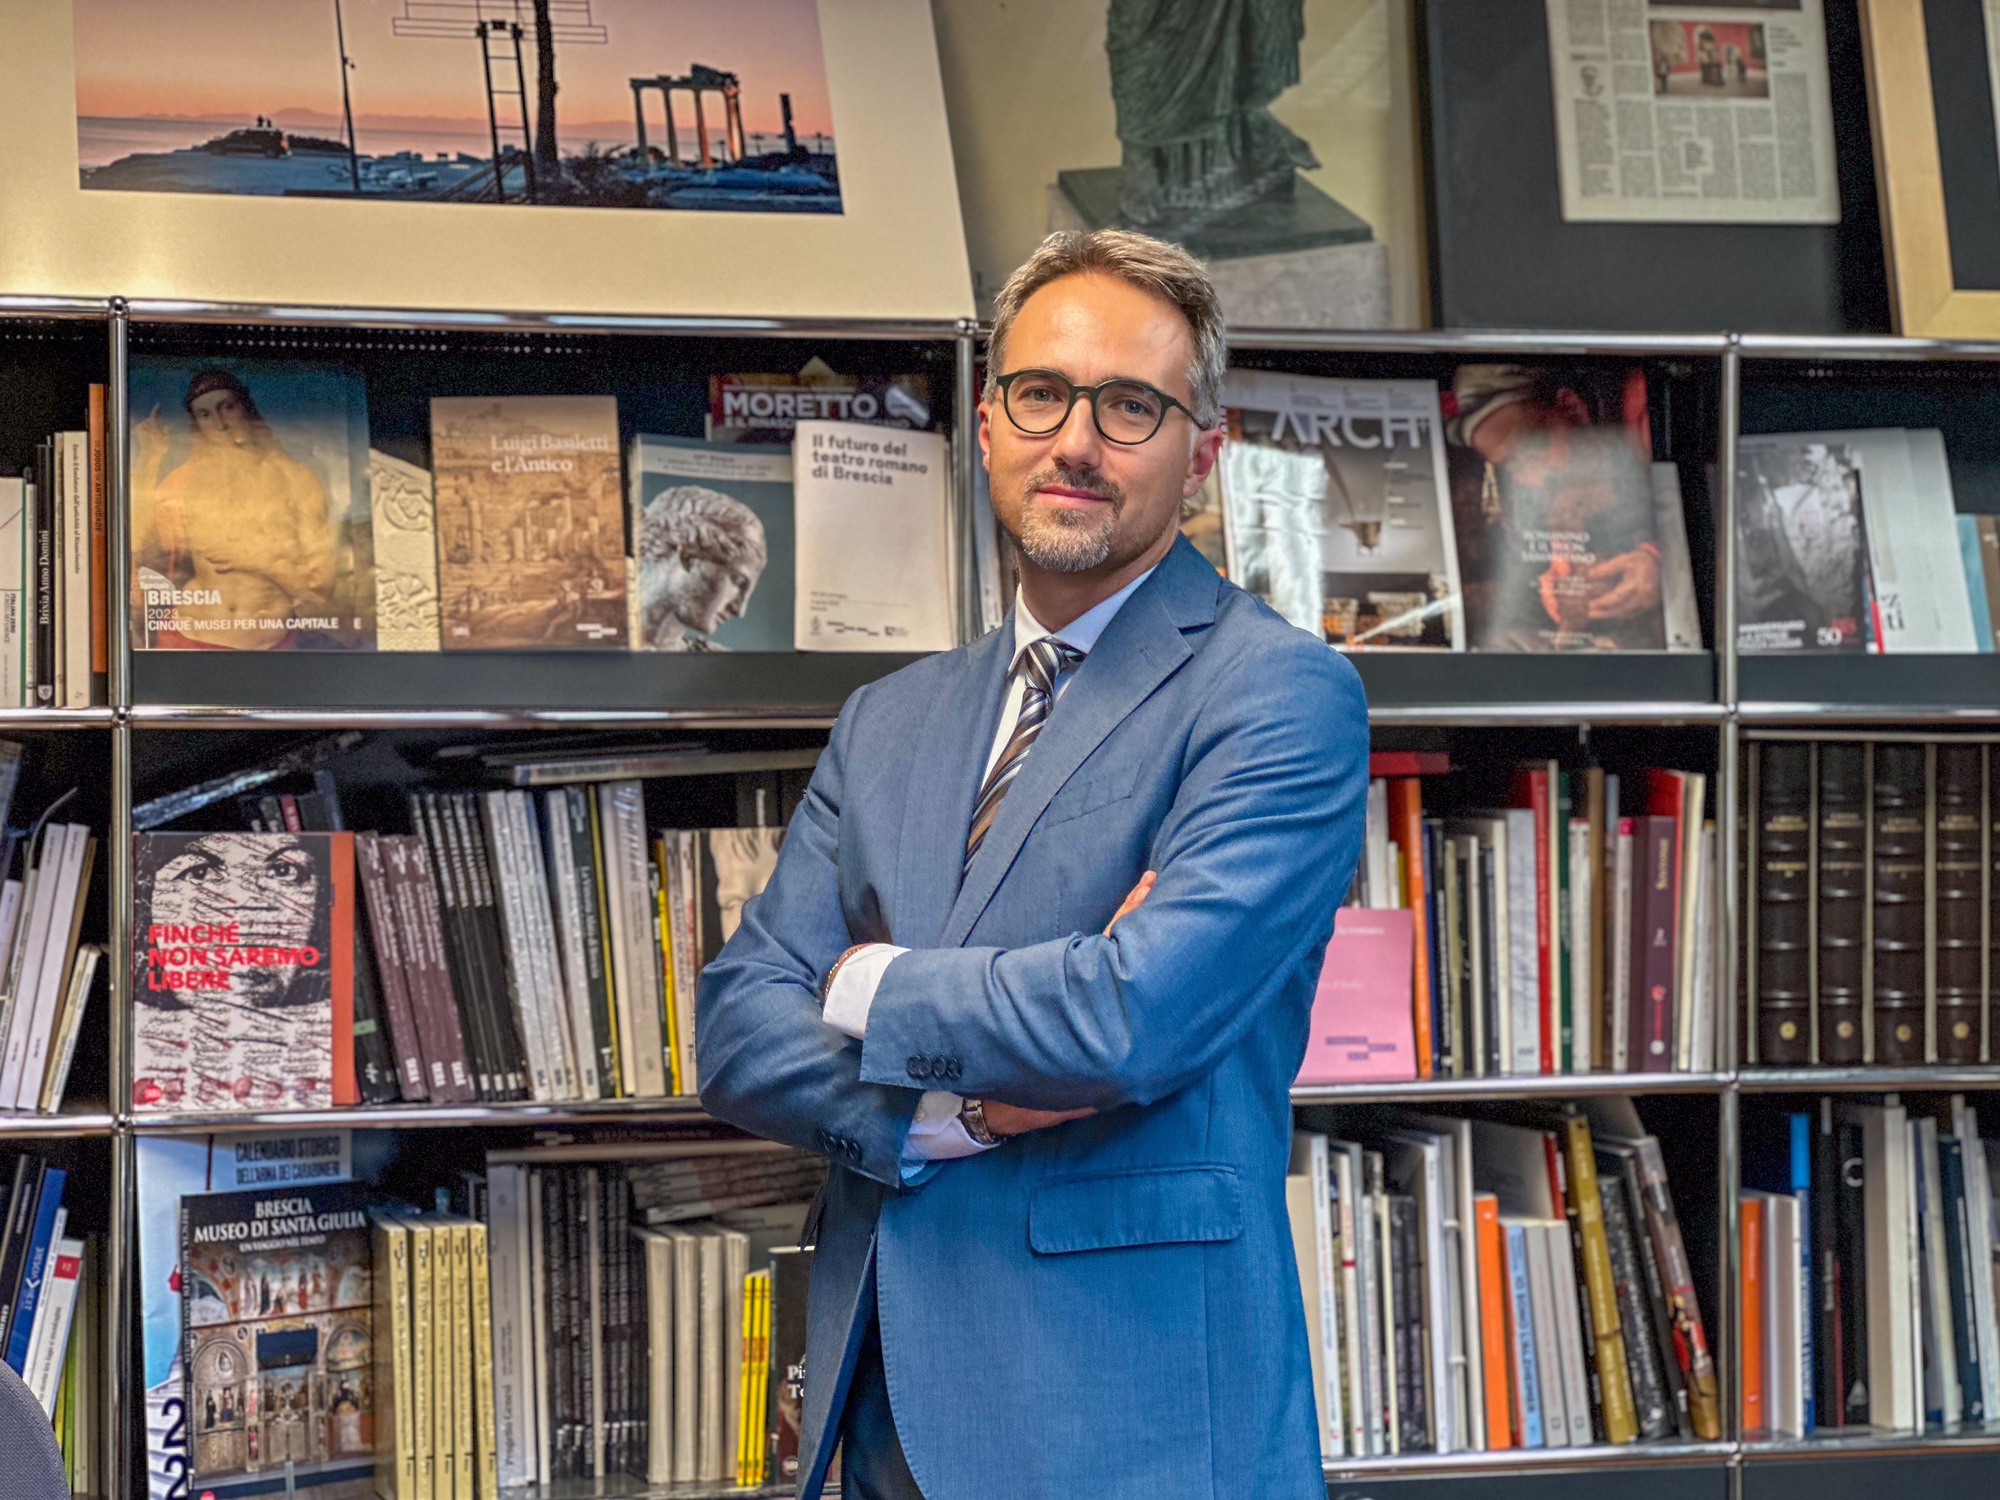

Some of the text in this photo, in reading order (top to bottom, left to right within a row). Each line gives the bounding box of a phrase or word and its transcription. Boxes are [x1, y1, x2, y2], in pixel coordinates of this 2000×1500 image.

[723, 392, 878, 418] MORETTO
[491, 433, 608, 455] Luigi Basiletti
[813, 434, 907, 456] Il futuro del
[491, 455, 573, 473] e l'Antico
[813, 451, 928, 474] teatro romano
[812, 465, 893, 486] di Brescia
[38, 530, 49, 624] Brixia Anno Domini
[148, 589, 223, 606] BRESCIA
[148, 608, 179, 619] 2023
[148, 617, 339, 631] CINQUE MUSEI PER UNA CAPITALE
[1816, 627, 1843, 646] 50
[148, 921, 240, 944] FINCHÉ
[148, 946, 320, 967] NON SAREMO
[148, 971, 232, 990] LIBERE
[236, 1136, 341, 1163] CALENDARIO STORICO
[279, 1165, 291, 1180] DEI
[293, 1161, 340, 1179] CARABINIERI
[255, 1197, 313, 1219] BRESCIA
[194, 1211, 367, 1244] MUSEO DI SANTA GIULIA
